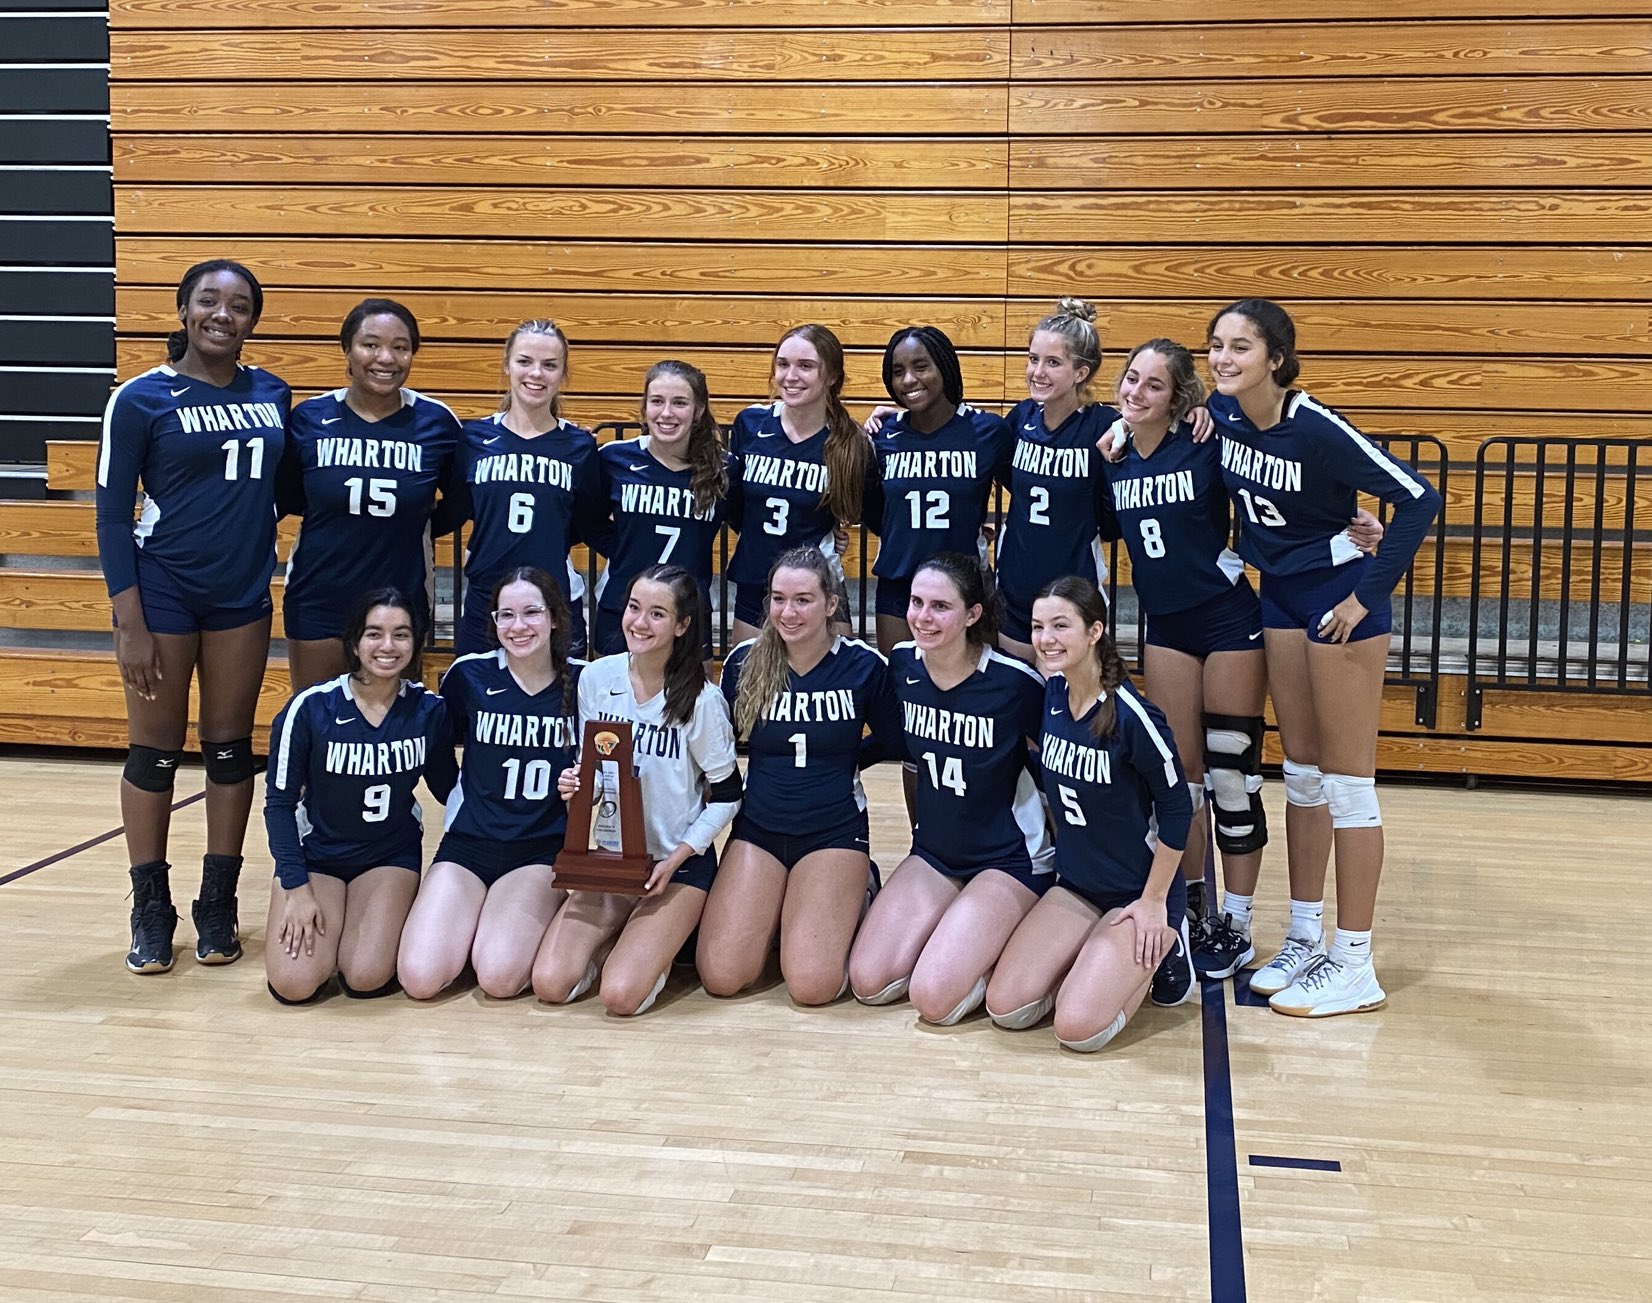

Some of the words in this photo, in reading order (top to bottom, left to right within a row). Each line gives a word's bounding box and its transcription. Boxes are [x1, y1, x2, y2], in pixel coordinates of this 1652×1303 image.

[176, 403, 283, 433] WHARTON
[222, 438, 263, 480] 11
[317, 438, 421, 472] WHARTON
[475, 454, 572, 491] WHARTON
[743, 454, 829, 492] WHARTON
[884, 451, 976, 480] WHARTON
[1012, 439, 1088, 477] WHARTON
[1221, 437, 1302, 492] WHARTON
[344, 478, 397, 517] 15
[622, 484, 715, 521] WHART
[905, 491, 949, 528] 12
[1029, 486, 1049, 525] 2
[1112, 470, 1194, 511] WHARTON
[1238, 489, 1287, 527] 13
[508, 493, 535, 533] 6
[763, 497, 789, 535] 3
[656, 525, 680, 564] 7
[1140, 519, 1165, 558] 8
[761, 690, 855, 721] ARTON
[476, 711, 577, 748] WHARTON
[599, 712, 681, 760] RTON
[903, 702, 994, 749] WHARTON
[326, 736, 425, 775] WHARTON
[788, 734, 806, 767] 1
[1042, 733, 1111, 784] WHARTON
[502, 758, 552, 800] 10
[922, 752, 967, 797] 14
[363, 784, 390, 822] 9
[1058, 784, 1086, 826] 5
